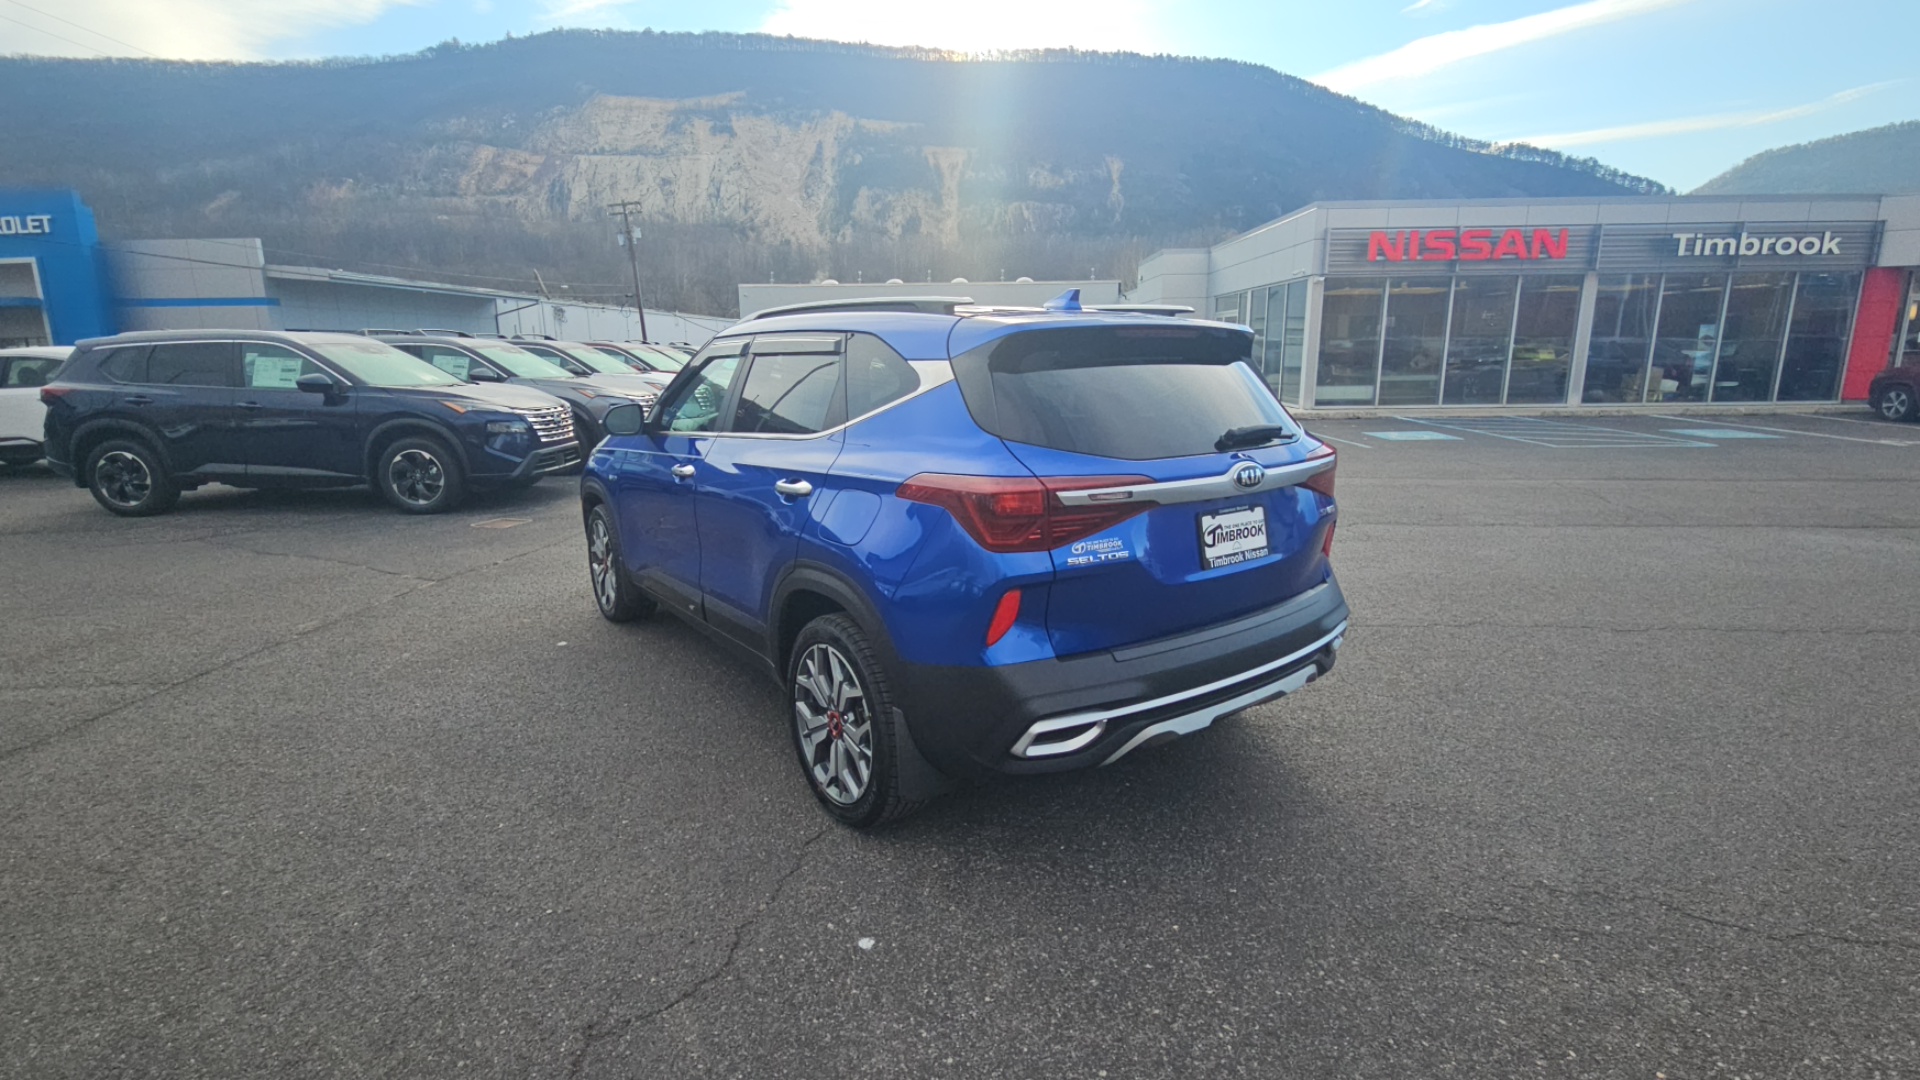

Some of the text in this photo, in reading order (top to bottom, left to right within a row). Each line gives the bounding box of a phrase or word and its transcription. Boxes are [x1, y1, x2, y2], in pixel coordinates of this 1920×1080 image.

[0, 215, 51, 234] OLET
[1367, 228, 1569, 262] NISSAN
[1673, 231, 1842, 257] Timbrook
[1240, 468, 1262, 485] KIA
[1086, 539, 1124, 551] TIMBROOK
[1204, 523, 1265, 548] TIMBROOK
[1067, 550, 1130, 566] SELTOS
[1209, 548, 1269, 568] Timbrook Nissan
